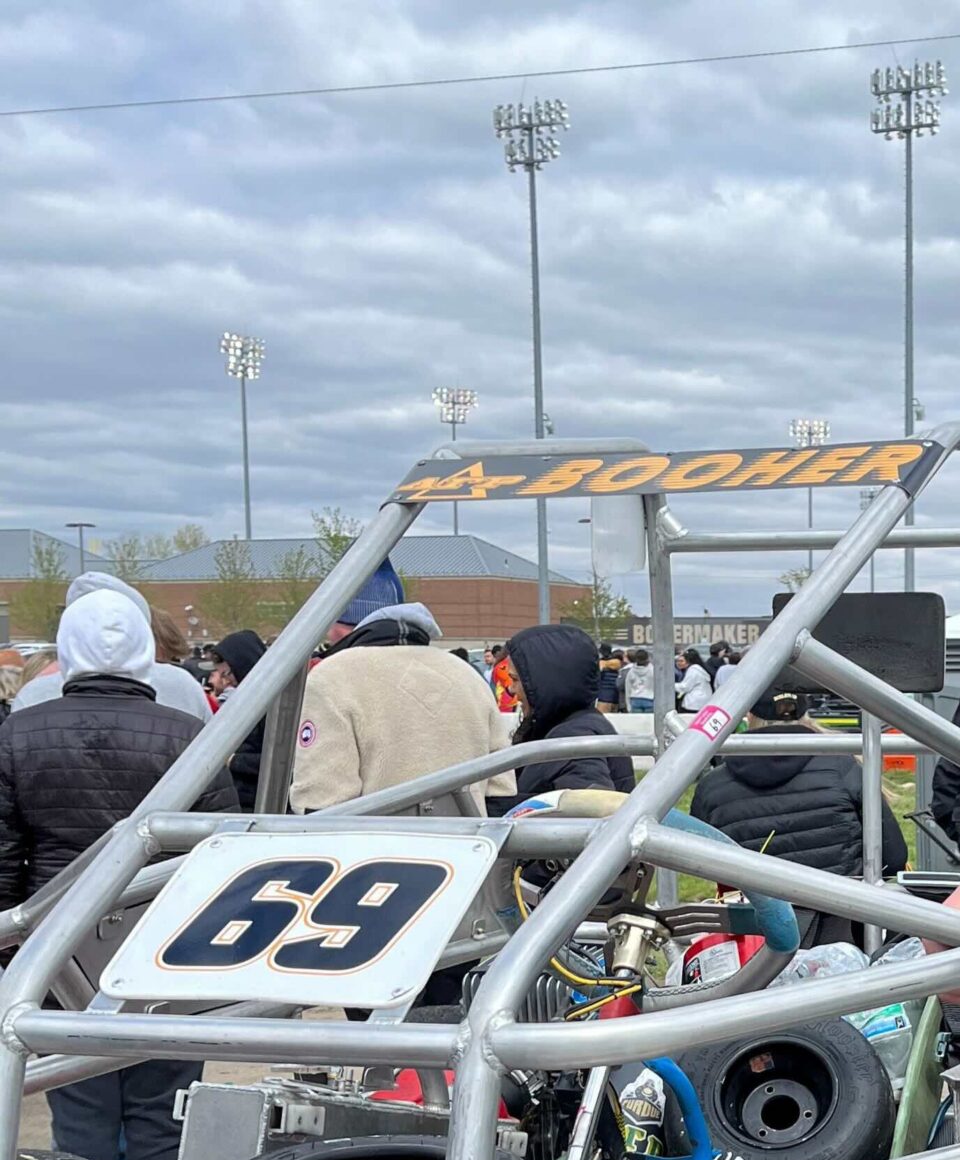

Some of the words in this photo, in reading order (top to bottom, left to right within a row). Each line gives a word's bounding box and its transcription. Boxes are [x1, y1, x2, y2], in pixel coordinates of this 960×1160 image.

[512, 443, 926, 496] BOOHER
[632, 624, 760, 644] BOERMAKER
[154, 857, 456, 976] 69
